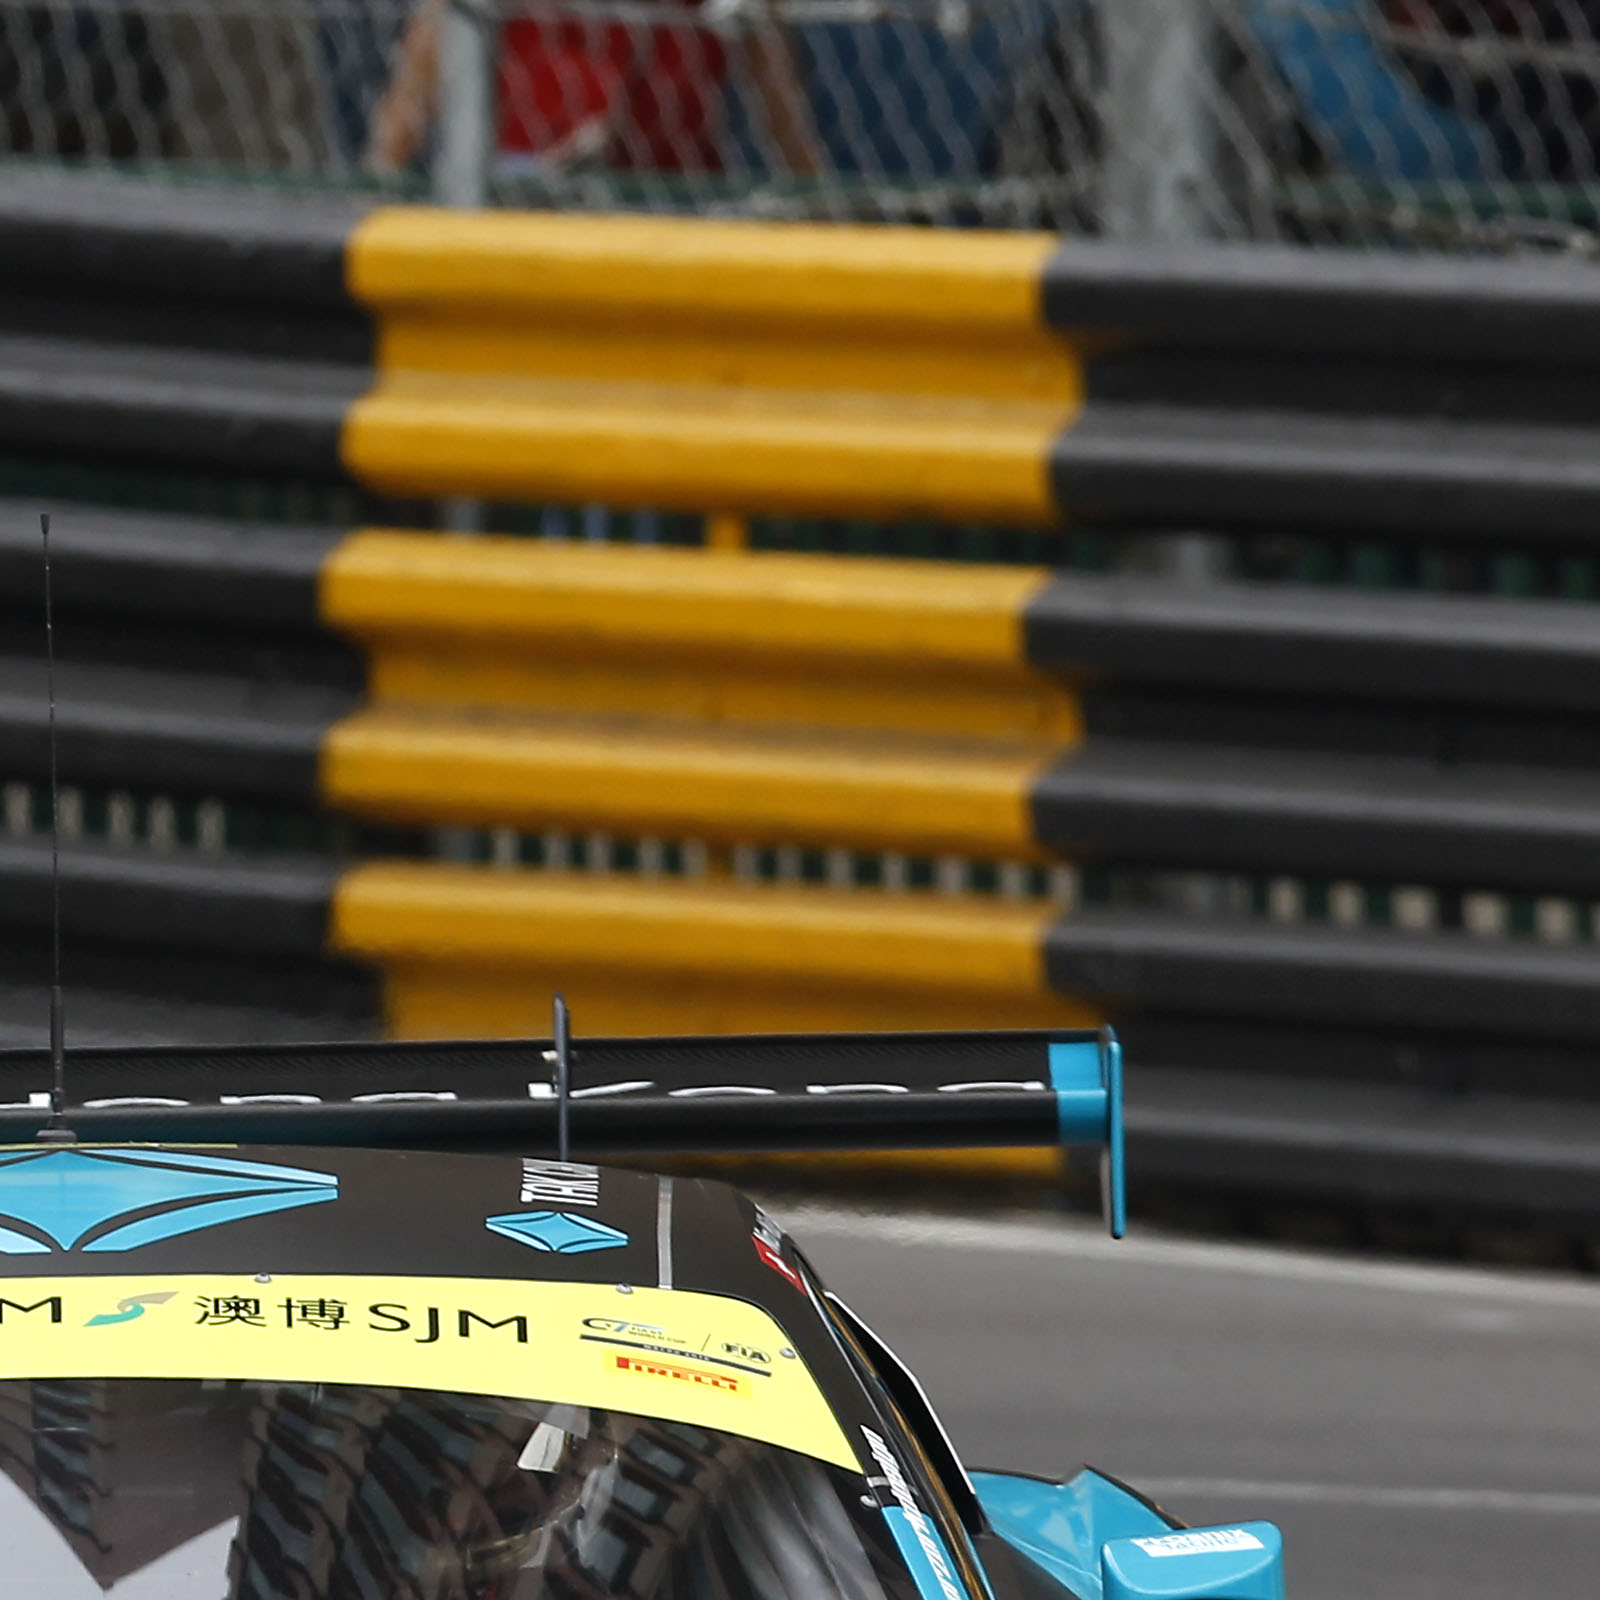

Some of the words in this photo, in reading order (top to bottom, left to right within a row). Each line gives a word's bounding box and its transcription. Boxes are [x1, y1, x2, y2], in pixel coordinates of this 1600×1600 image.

[194, 1295, 350, 1331] 澳博
[368, 1302, 530, 1344] SJM
[722, 1342, 769, 1363] FIA
[616, 1356, 738, 1392] PIRELLI
